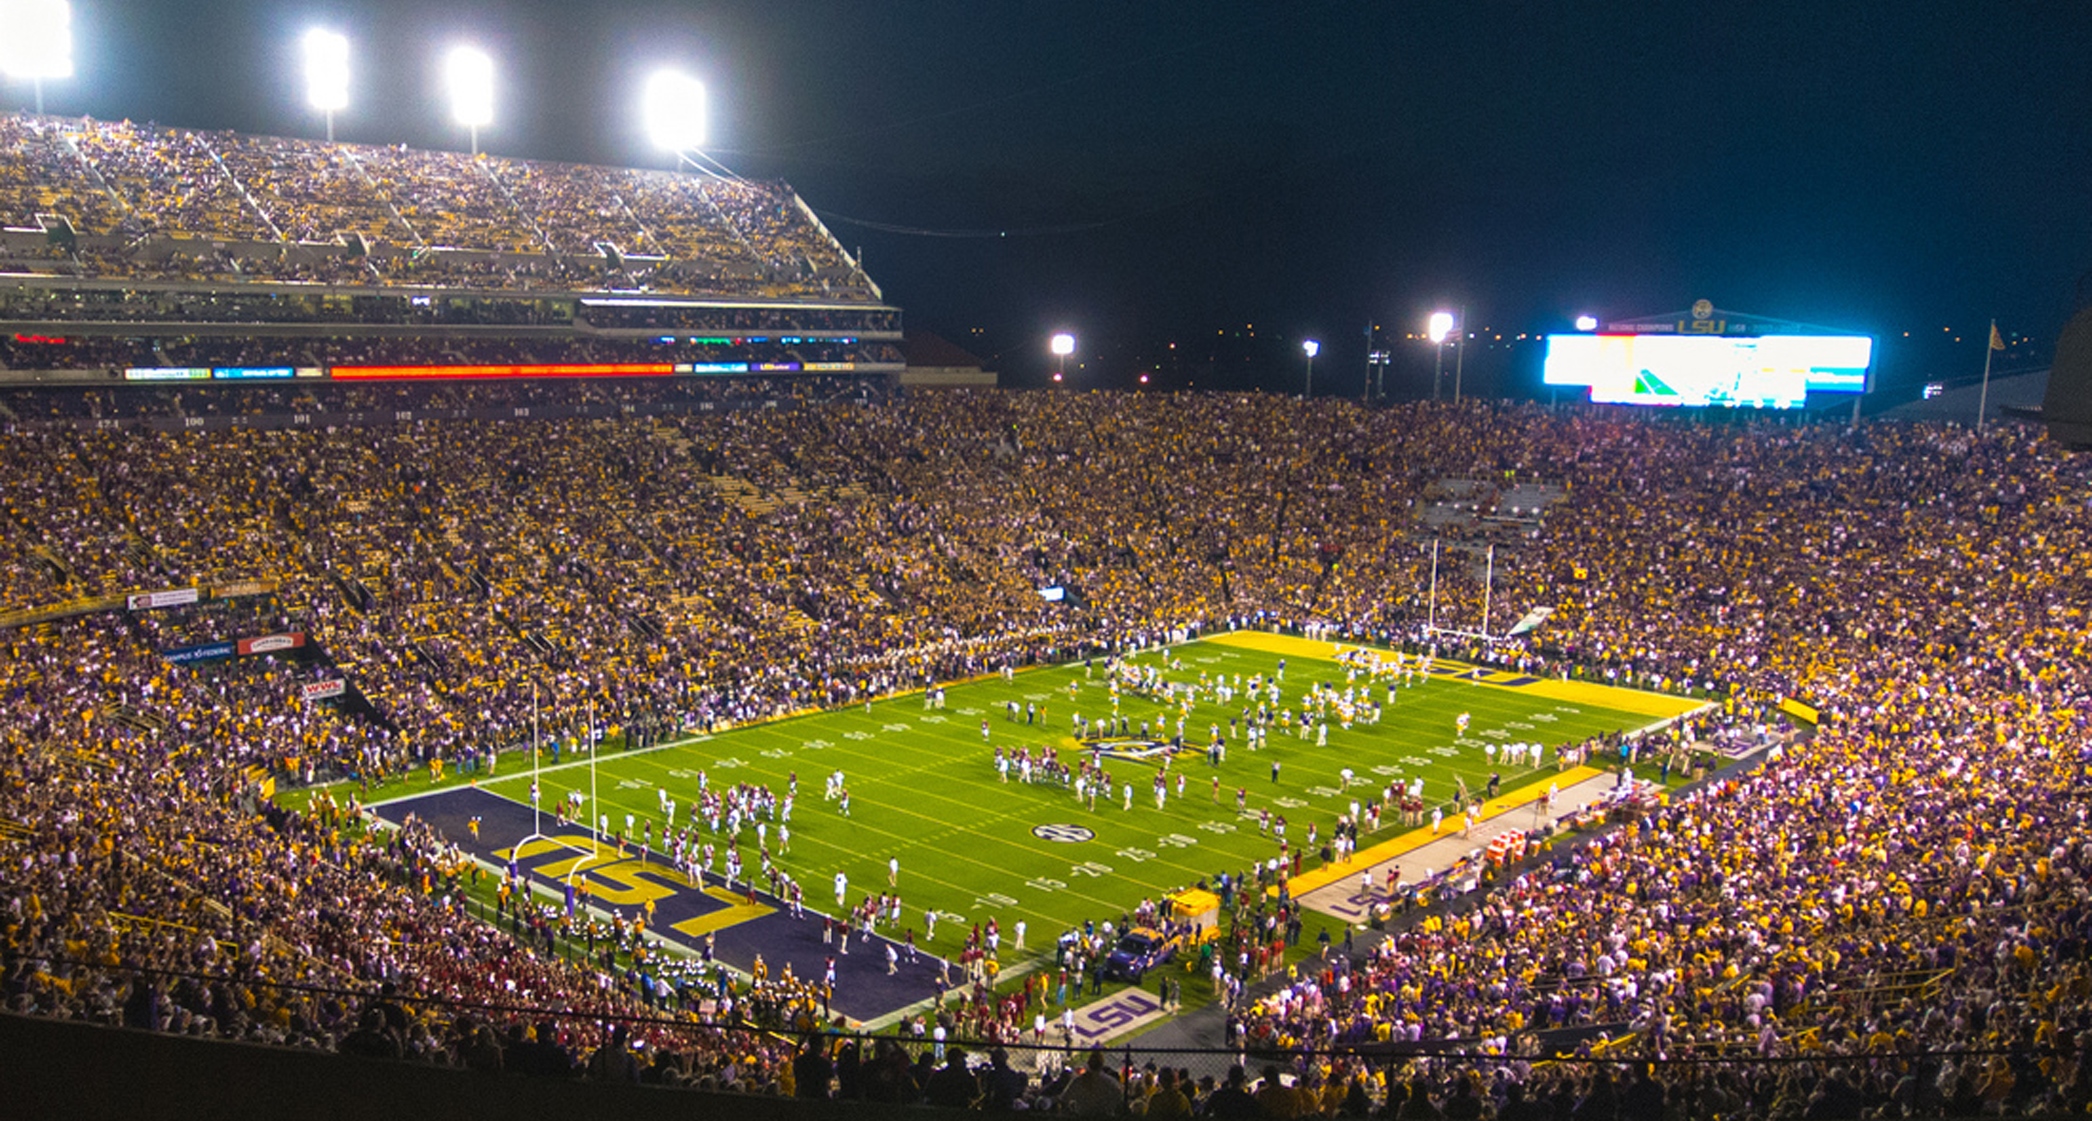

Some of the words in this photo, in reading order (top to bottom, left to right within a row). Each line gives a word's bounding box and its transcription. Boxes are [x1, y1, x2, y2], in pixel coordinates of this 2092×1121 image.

[1678, 320, 1726, 334] LSU
[185, 416, 205, 427] 100
[491, 835, 778, 938] LSU
[1074, 995, 1159, 1038] LSU
